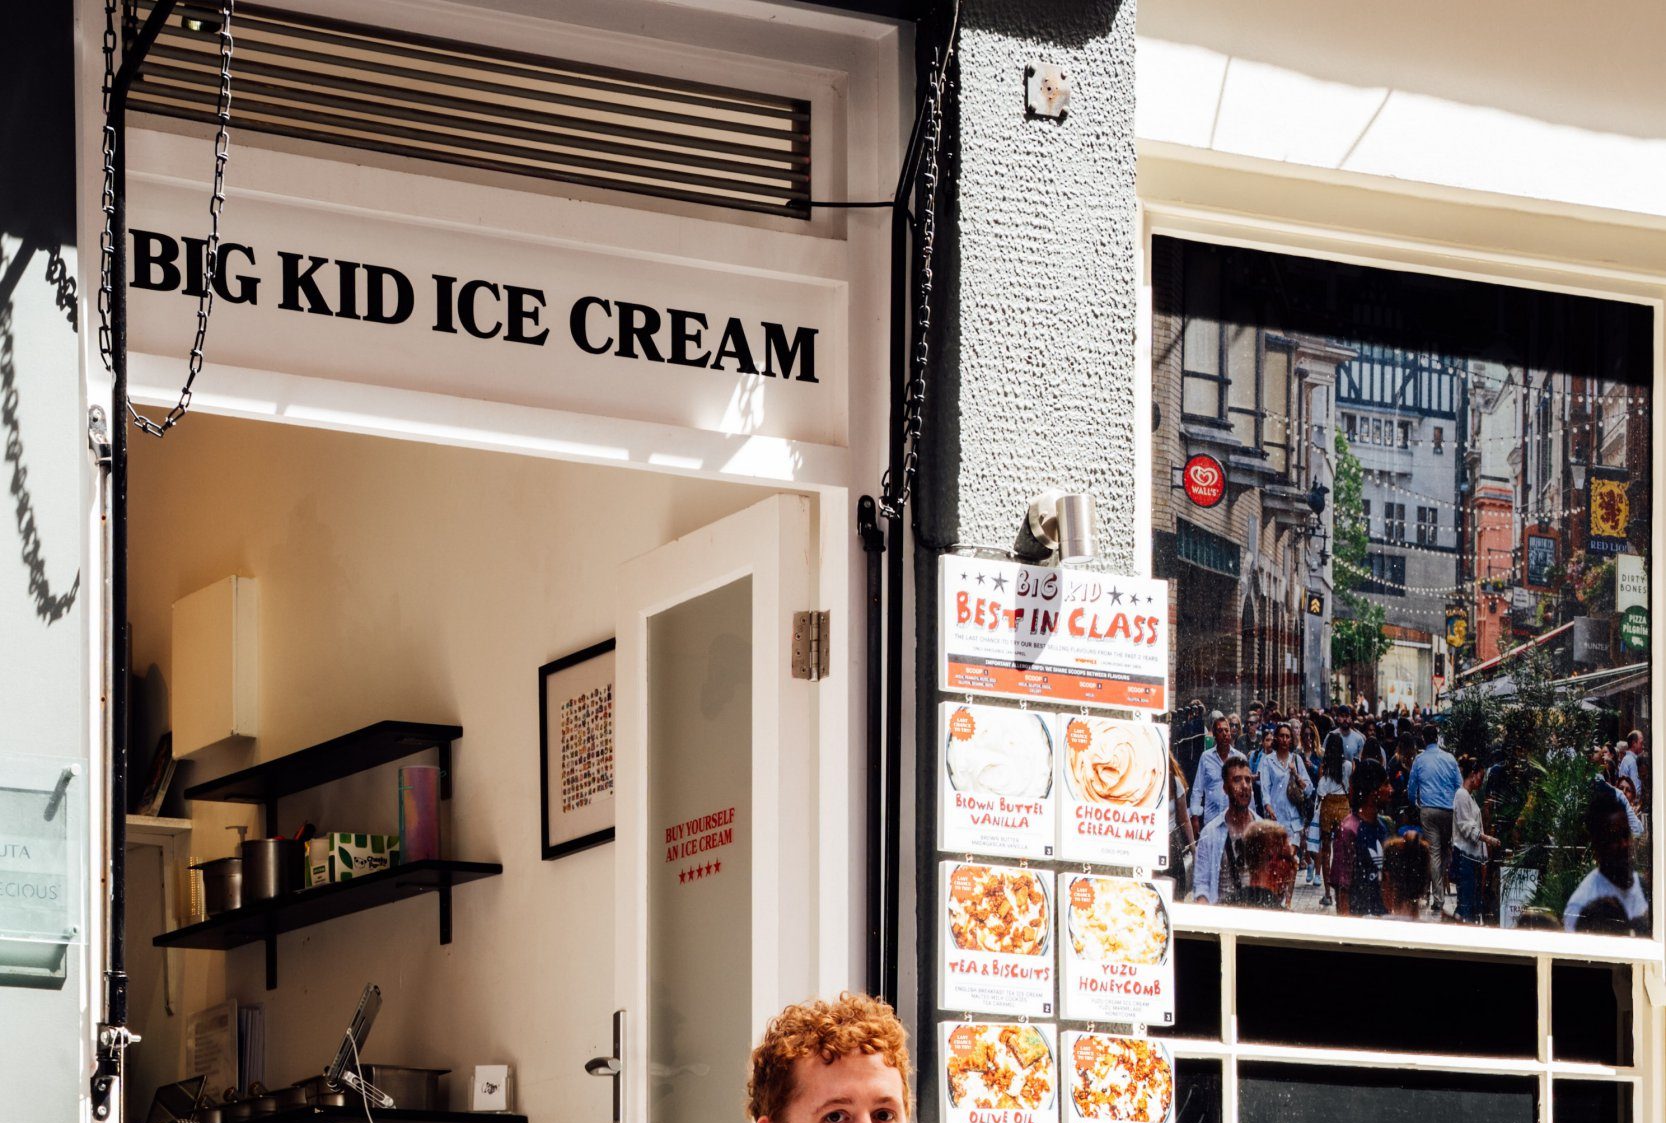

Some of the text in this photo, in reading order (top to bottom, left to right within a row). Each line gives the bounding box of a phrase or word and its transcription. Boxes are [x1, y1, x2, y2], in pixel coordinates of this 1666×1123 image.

[128, 228, 820, 384] BIG KID ICE CREAM
[1192, 486, 1217, 496] WALL'S
[1590, 540, 1608, 550] RED
[1016, 569, 1058, 601] BIG
[1620, 584, 1647, 594] BONES
[1621, 574, 1645, 584] DIRTY
[956, 590, 1160, 648] BEST IN CLASS
[1020, 640, 1032, 648] OUR
[1142, 654, 1158, 662] YEARS
[955, 793, 1044, 816] BROWN BUTTER
[666, 808, 735, 844] BUY YOURSELF
[970, 814, 1030, 828] VANILLA
[1076, 806, 1156, 826] CHOCOLATE
[1078, 822, 1155, 842] CEREAL MILK
[666, 828, 732, 862] AN ICE CREAM
[949, 960, 1050, 981] TEA & BISCUITS
[1102, 964, 1138, 977] YUZU
[1079, 976, 1162, 996] HONEYCOMB
